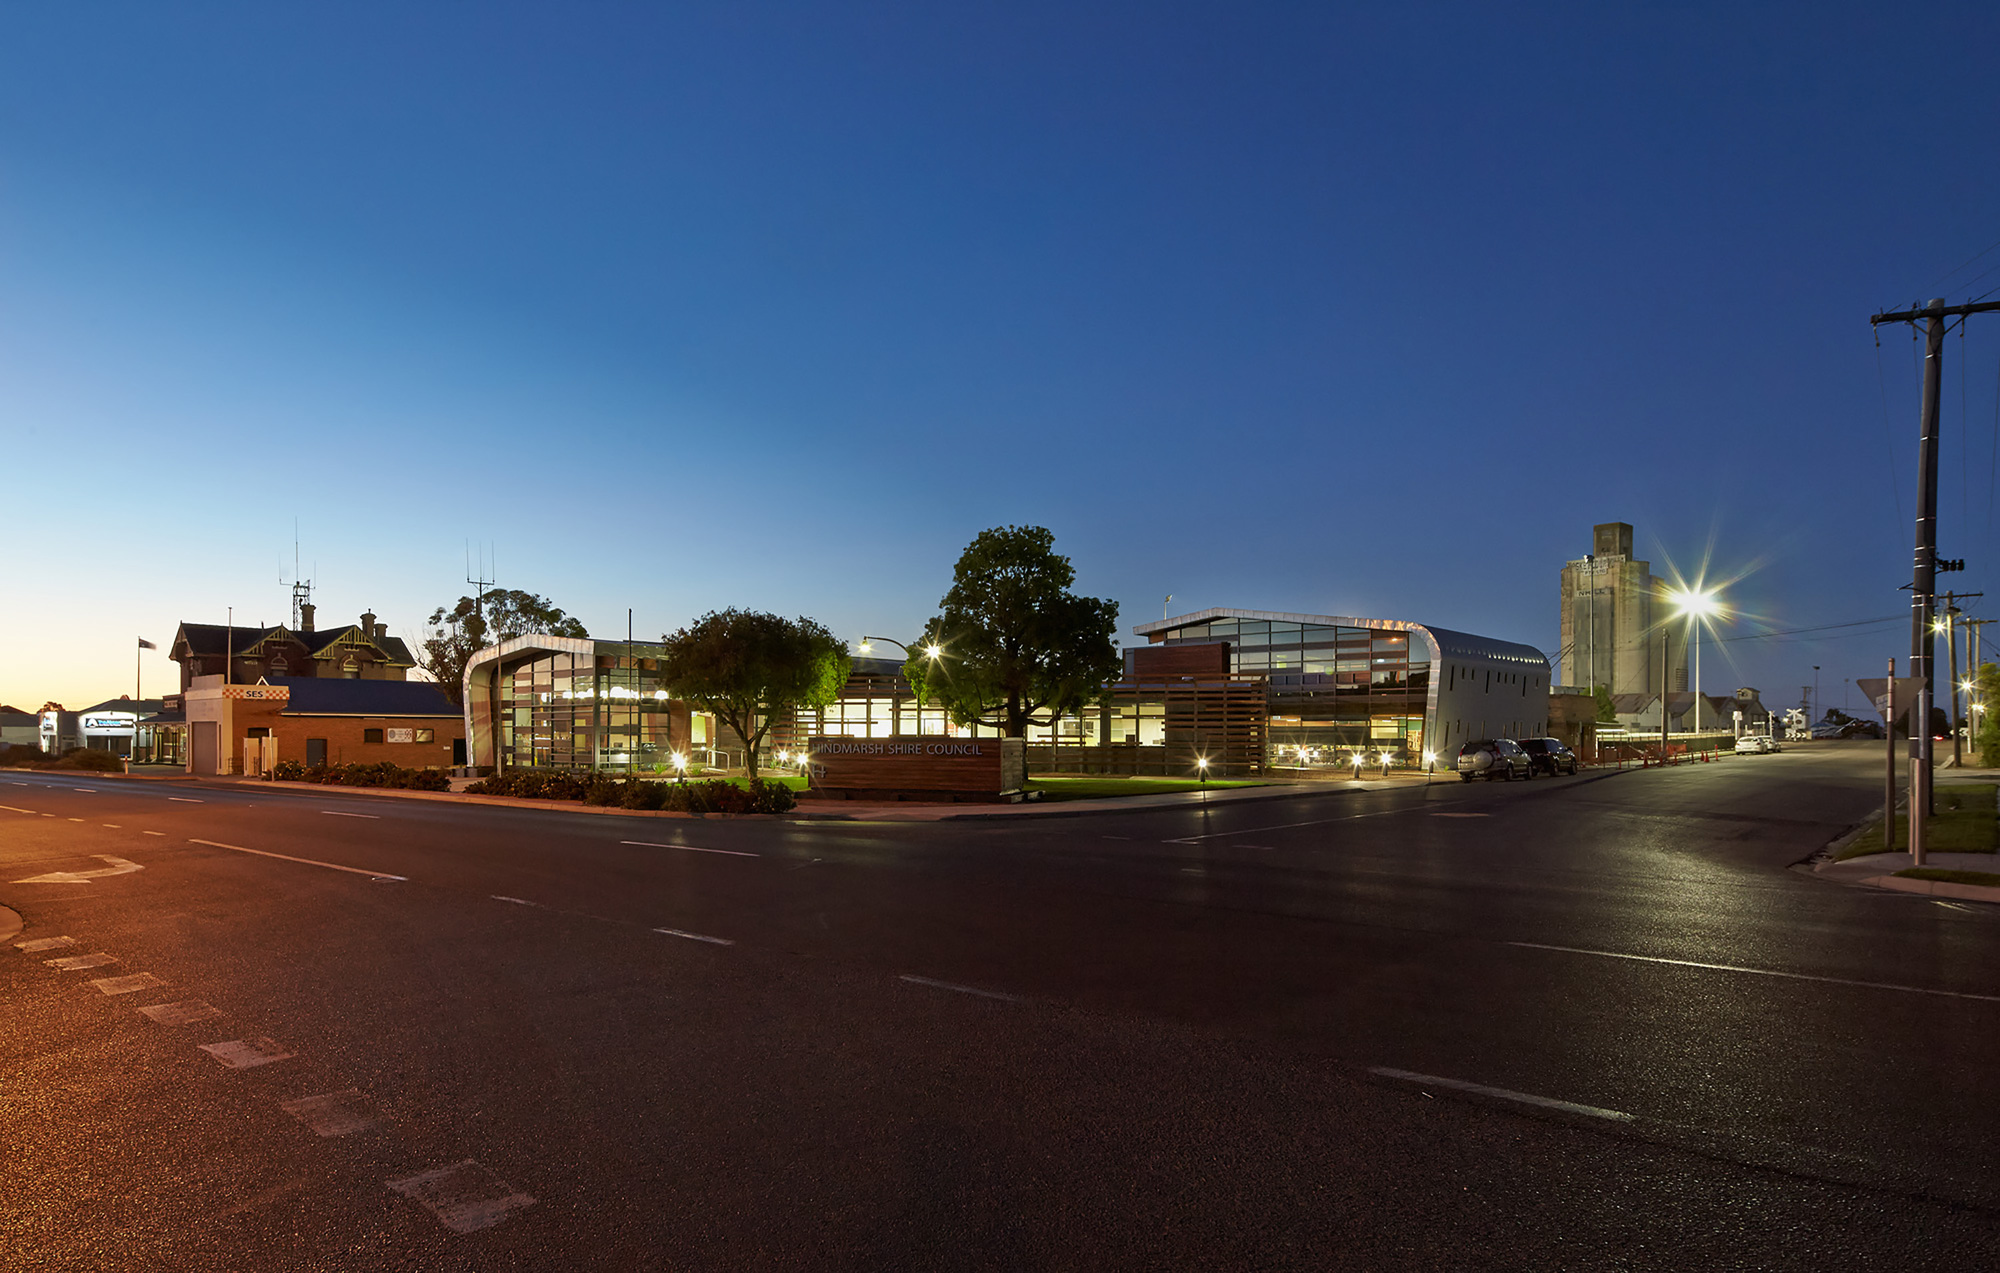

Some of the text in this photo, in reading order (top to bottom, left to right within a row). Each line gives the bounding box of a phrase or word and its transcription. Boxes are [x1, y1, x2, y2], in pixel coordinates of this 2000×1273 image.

[246, 690, 263, 698] SES
[812, 743, 983, 755] HINDMARSH SHIRE COUNCIL
